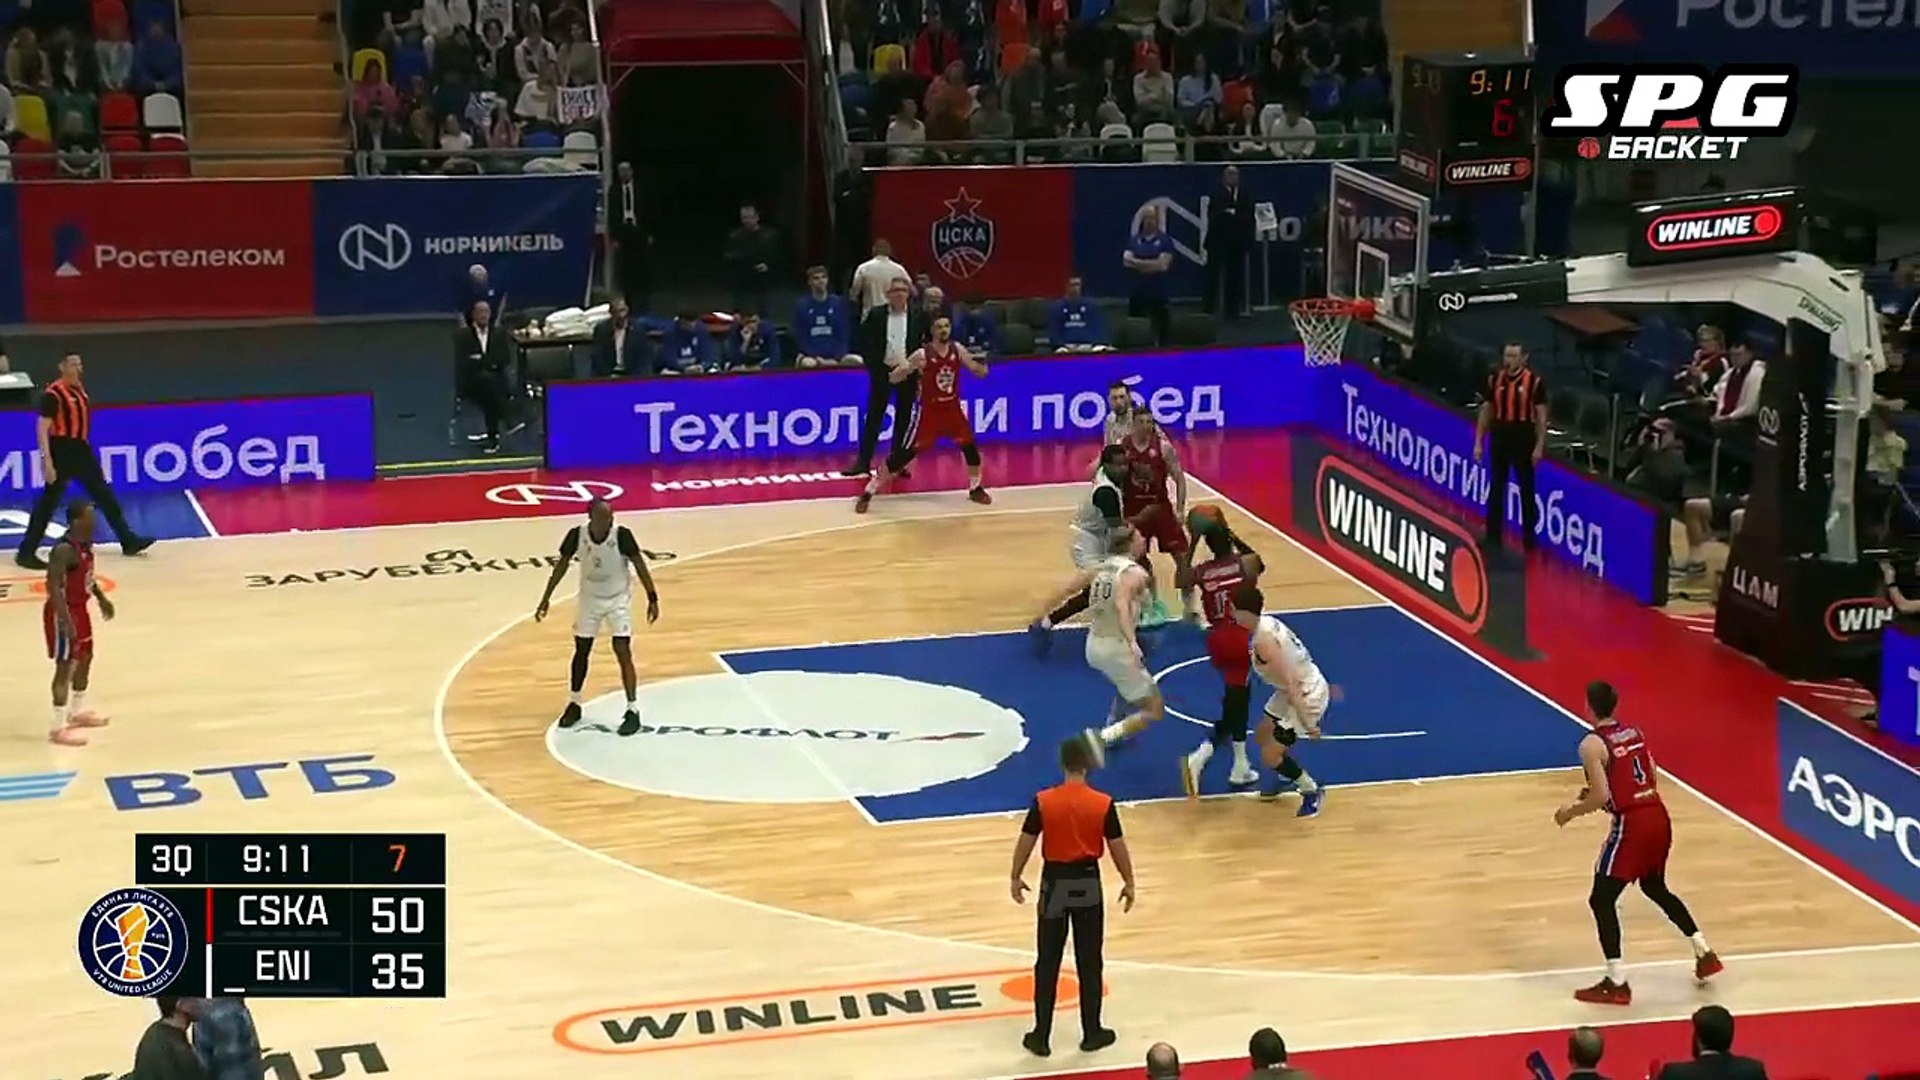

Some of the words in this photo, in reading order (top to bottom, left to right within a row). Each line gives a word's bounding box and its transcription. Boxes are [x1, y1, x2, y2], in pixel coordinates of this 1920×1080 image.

[1469, 68, 1530, 95] 9:11
[1492, 98, 1515, 137] 6
[1452, 163, 1512, 179] WINLINE
[424, 234, 564, 254] НОРНИКЕЛЬ
[938, 227, 987, 245] ЦСКА
[1658, 216, 1752, 242] WINLINE
[95, 245, 285, 268] Ростелеком
[634, 397, 1008, 454] Техноли
[99, 424, 326, 484] побед
[651, 468, 878, 492] НОРНИКЕ
[1328, 477, 1447, 592] WINLINE
[244, 550, 677, 588] ЗАРУБЕЖНЬ
[105, 755, 396, 811] ВТБ
[1632, 755, 1647, 786] 4
[600, 983, 982, 1045] WINLINE
